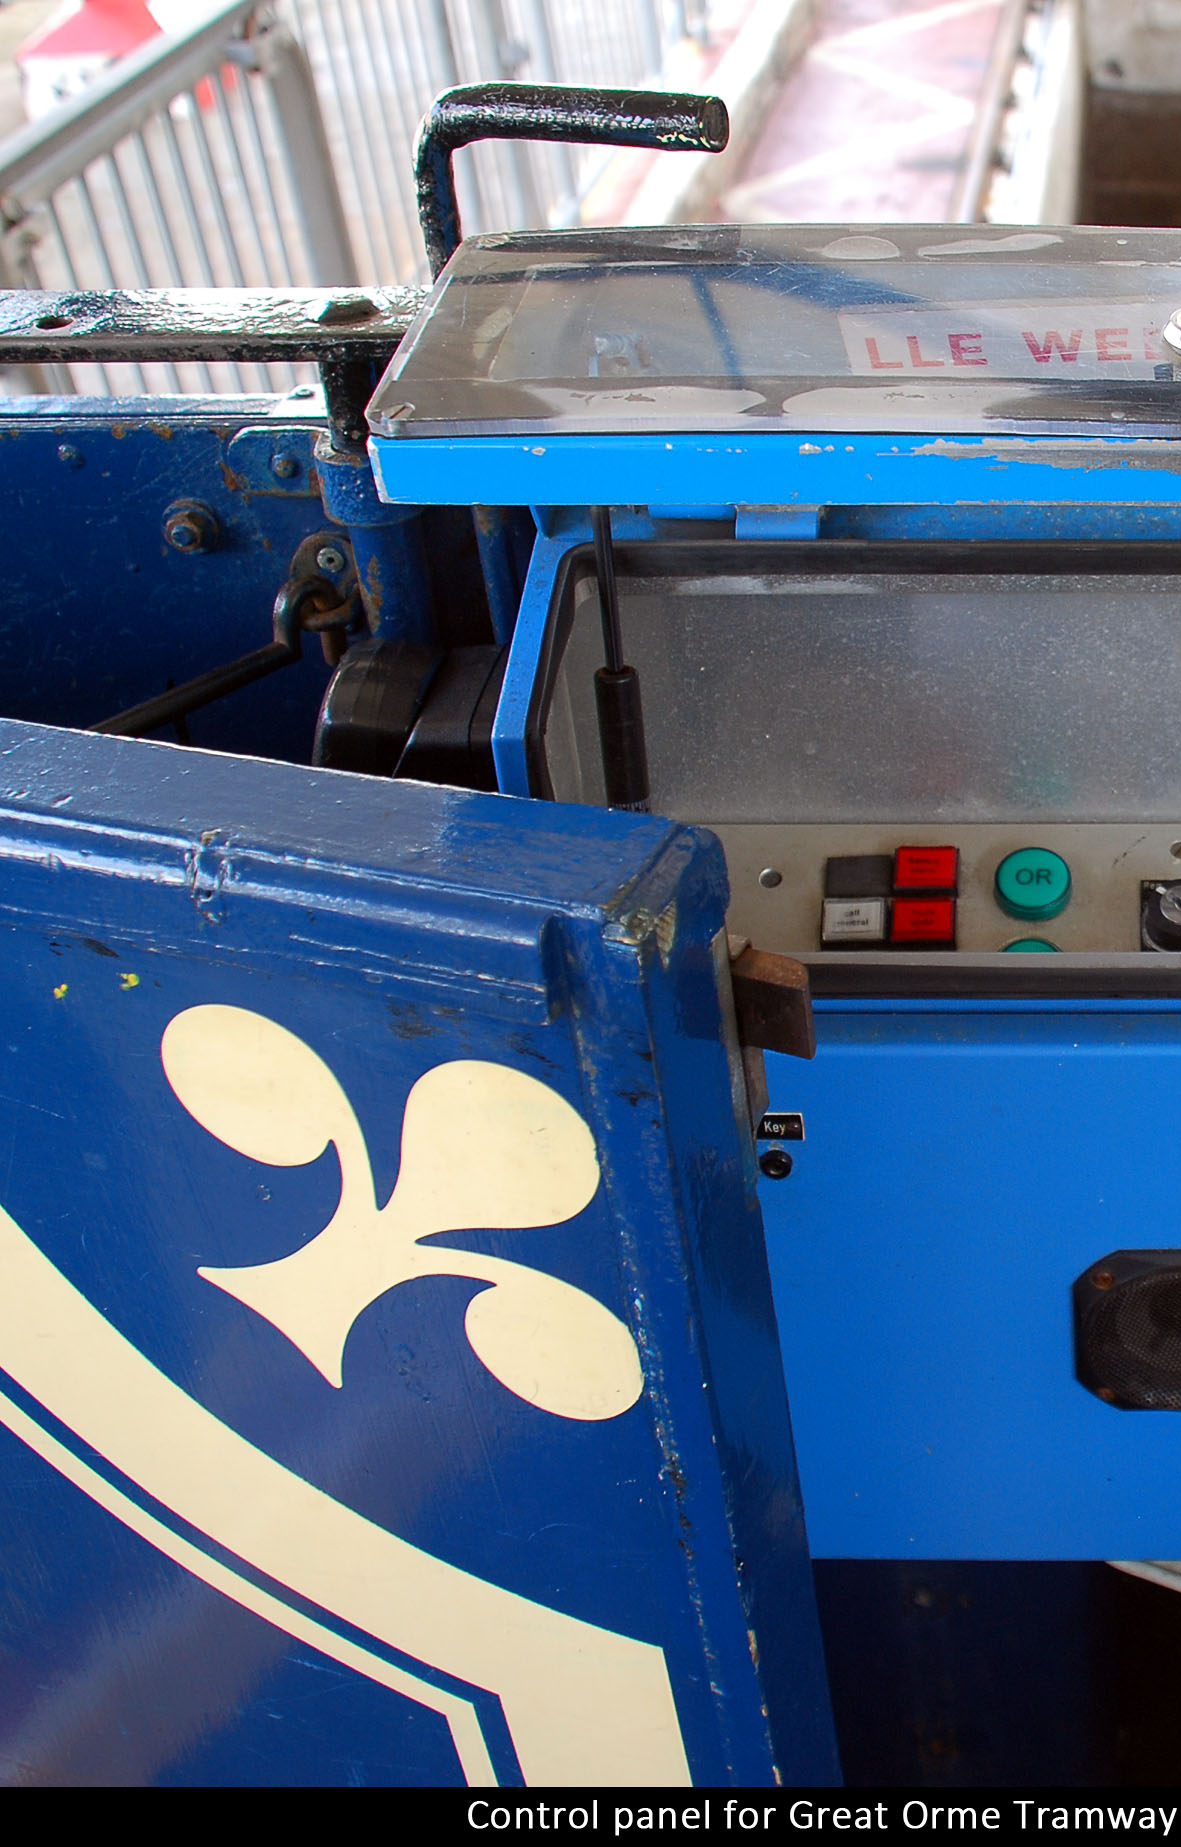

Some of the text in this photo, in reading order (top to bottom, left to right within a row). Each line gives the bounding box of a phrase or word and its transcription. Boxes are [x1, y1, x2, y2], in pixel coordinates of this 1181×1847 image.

[864, 333, 988, 369] LLE
[1021, 327, 1164, 363] WE
[1015, 867, 1053, 887] OR
[763, 1120, 786, 1136] Key
